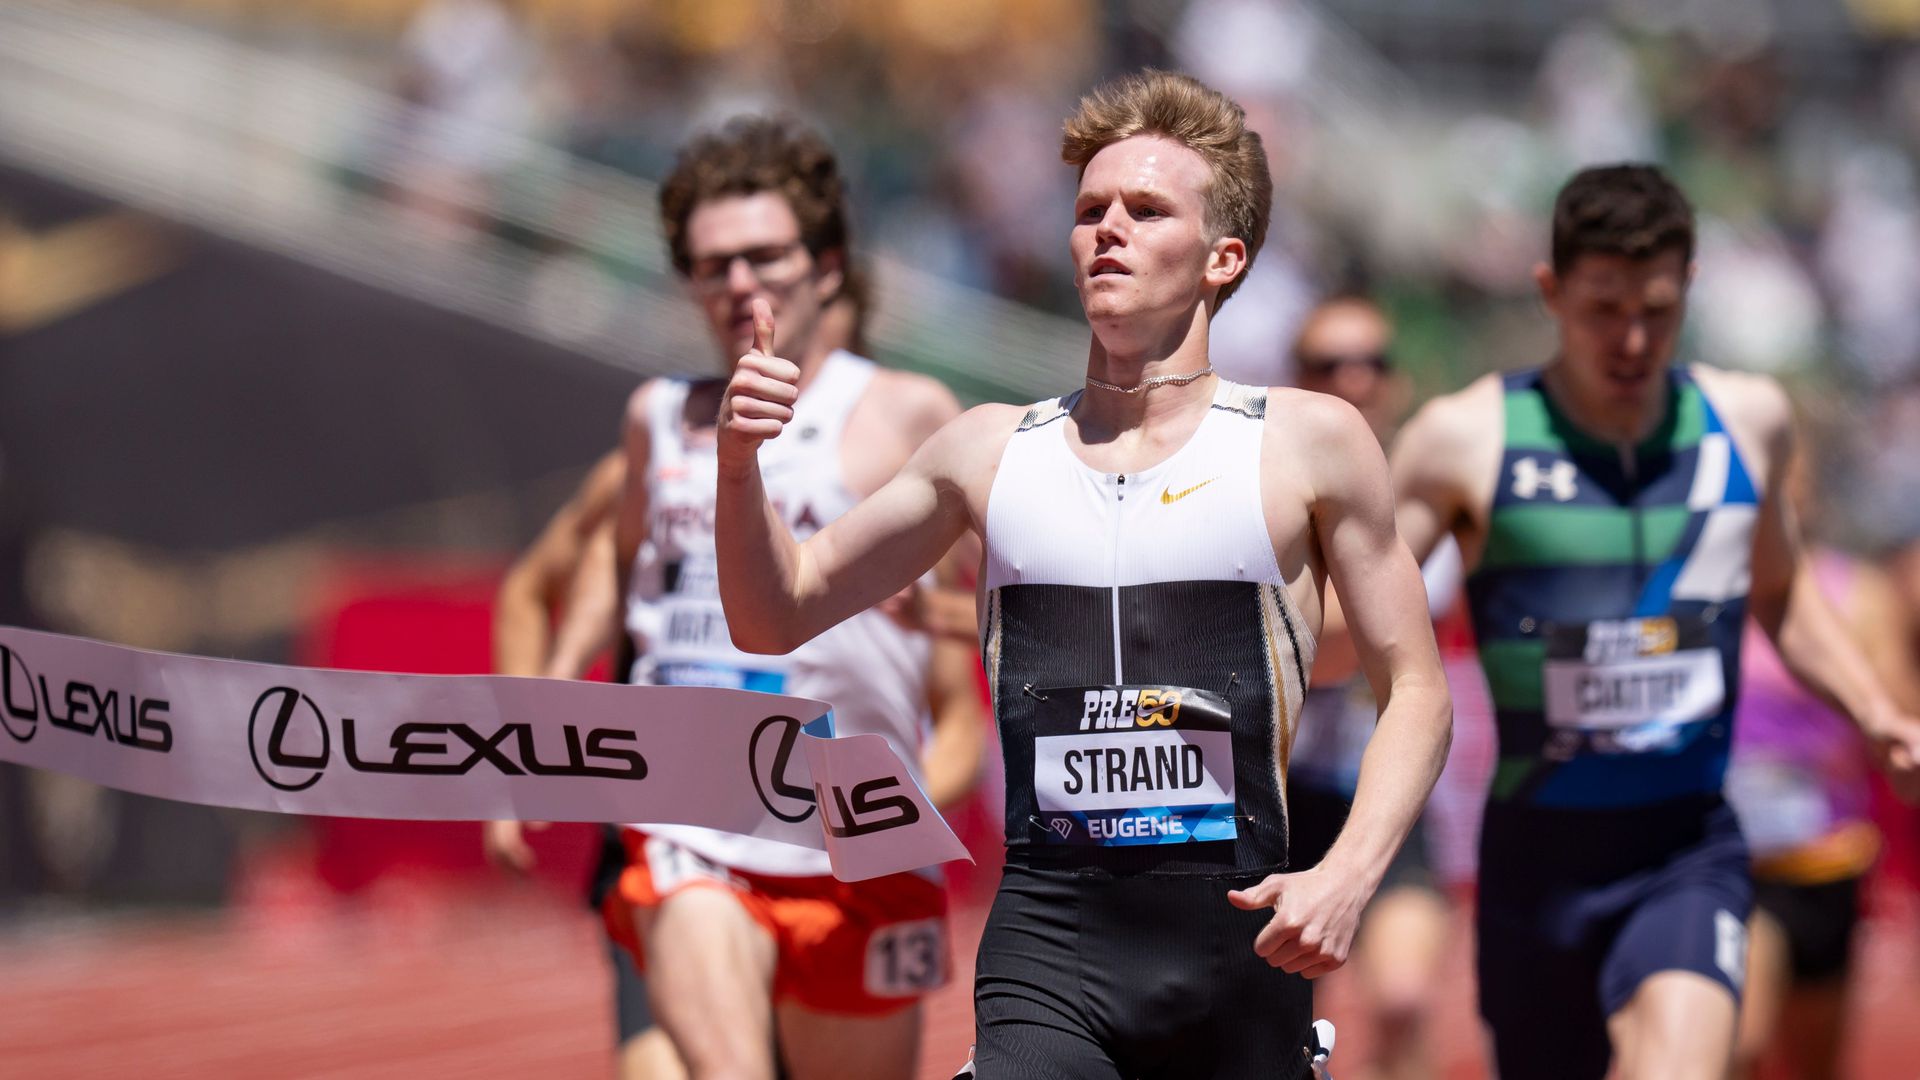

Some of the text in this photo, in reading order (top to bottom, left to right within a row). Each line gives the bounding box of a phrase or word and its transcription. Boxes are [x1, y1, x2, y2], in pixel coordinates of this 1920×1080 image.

[38, 675, 172, 753] LEXUS
[342, 719, 648, 781] LEXUS
[1079, 689, 1183, 731] PRE50
[1063, 744, 1204, 795] STRAND
[1088, 815, 1183, 839] EUGENE
[875, 929, 939, 988] 13
